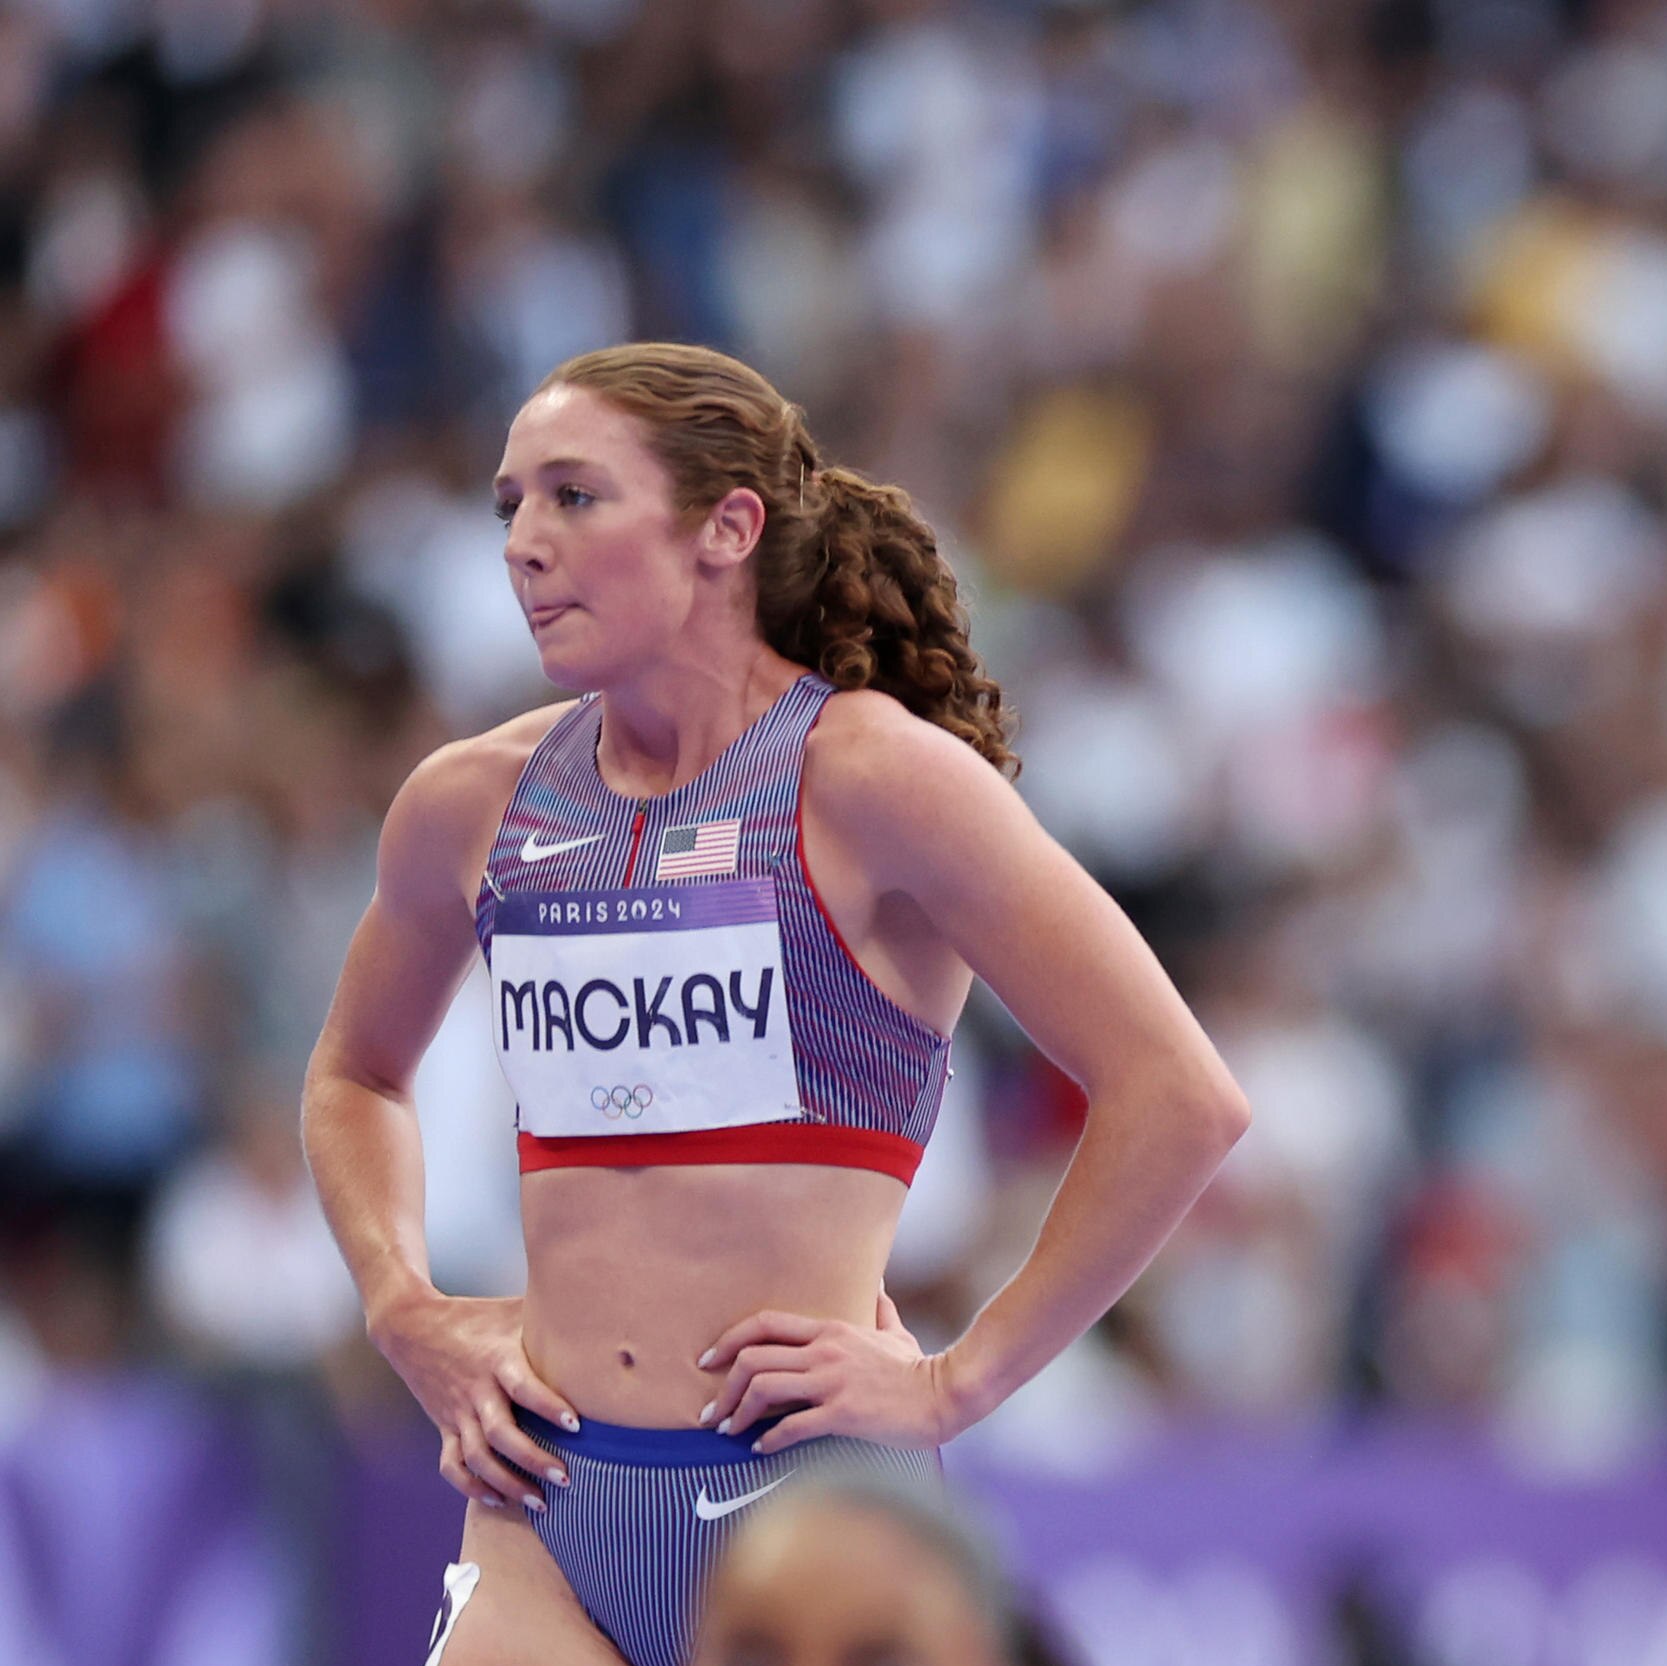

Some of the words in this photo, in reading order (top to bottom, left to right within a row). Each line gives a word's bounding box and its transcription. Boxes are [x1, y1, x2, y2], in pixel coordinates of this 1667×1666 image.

[538, 901, 609, 924] PARIS
[617, 898, 681, 922] 2024
[500, 967, 774, 1052] MACKAY
